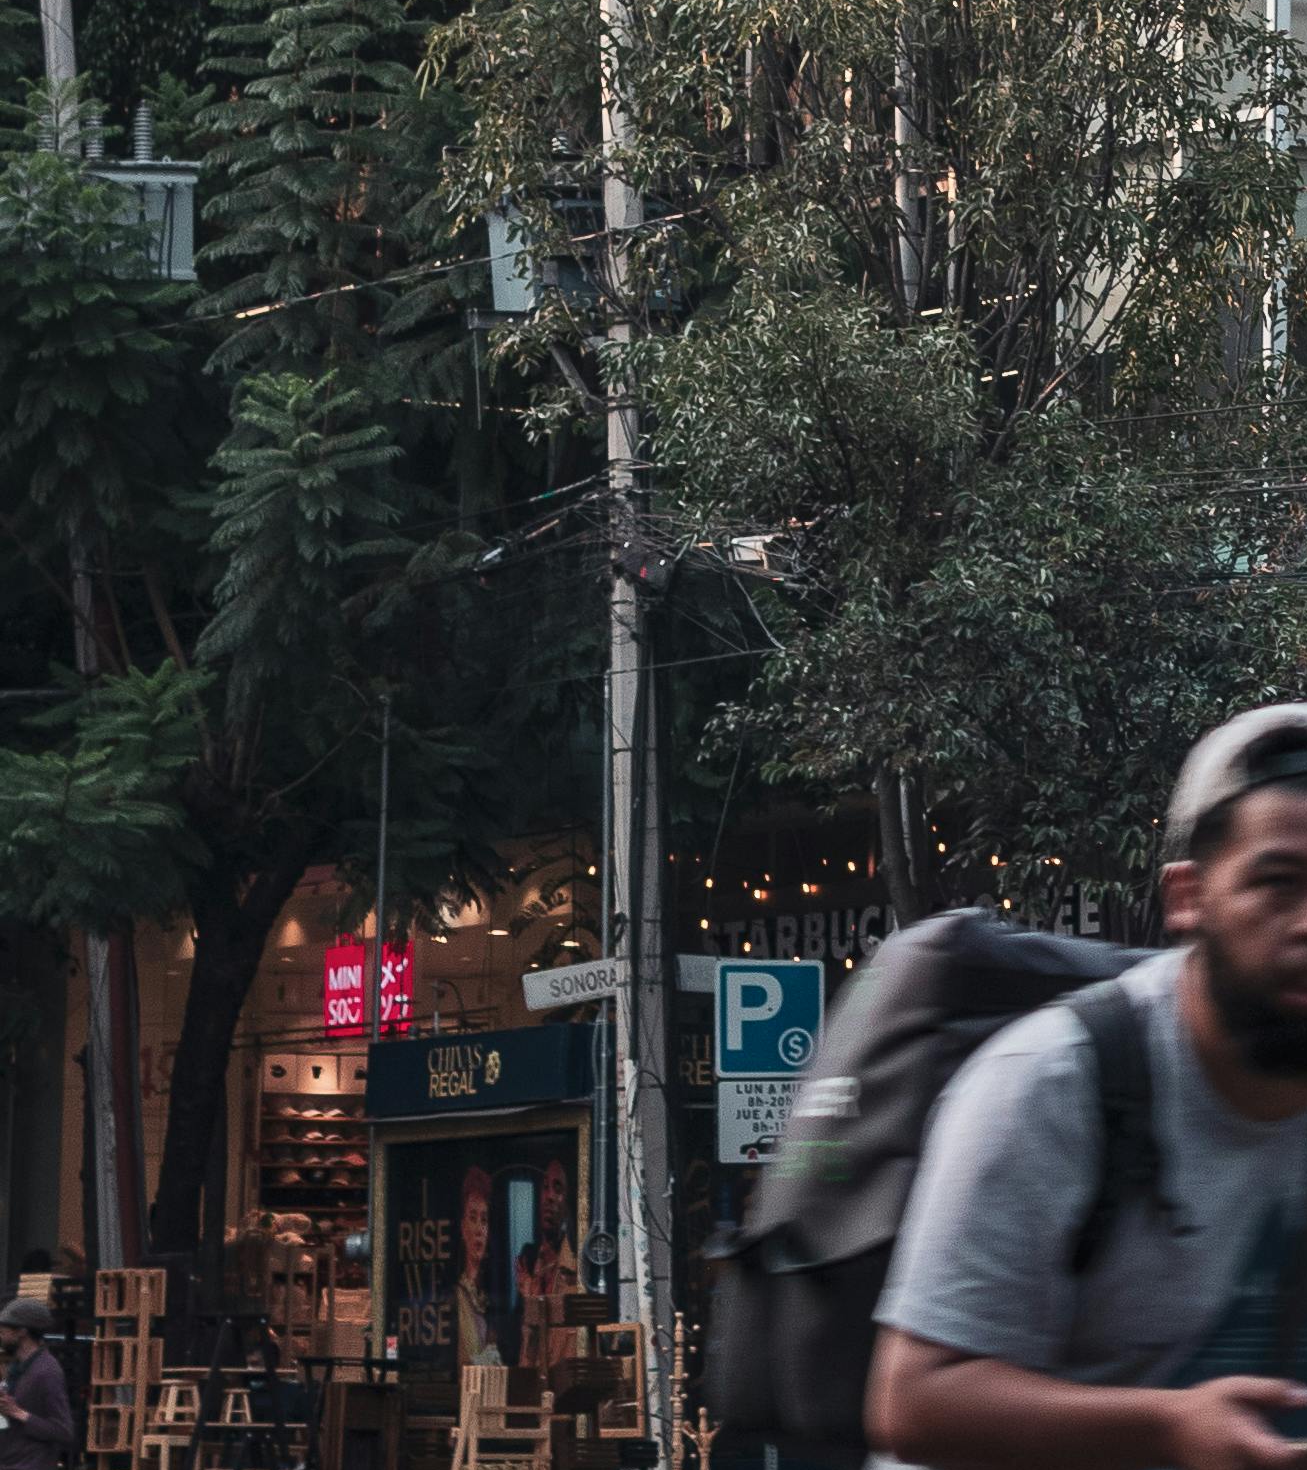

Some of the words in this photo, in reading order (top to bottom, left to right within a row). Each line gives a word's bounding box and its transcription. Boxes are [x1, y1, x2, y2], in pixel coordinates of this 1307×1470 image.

[550, 968, 617, 999] SONORA
[726, 972, 783, 1051] P
[429, 1070, 479, 1099] REGAL
[736, 1084, 763, 1095] LUN
[768, 1084, 777, 1095] A
[736, 1109, 761, 1120] JUE
[765, 1109, 774, 1120] A
[400, 1218, 451, 1260] RISE
[400, 1303, 451, 1347] RISE
